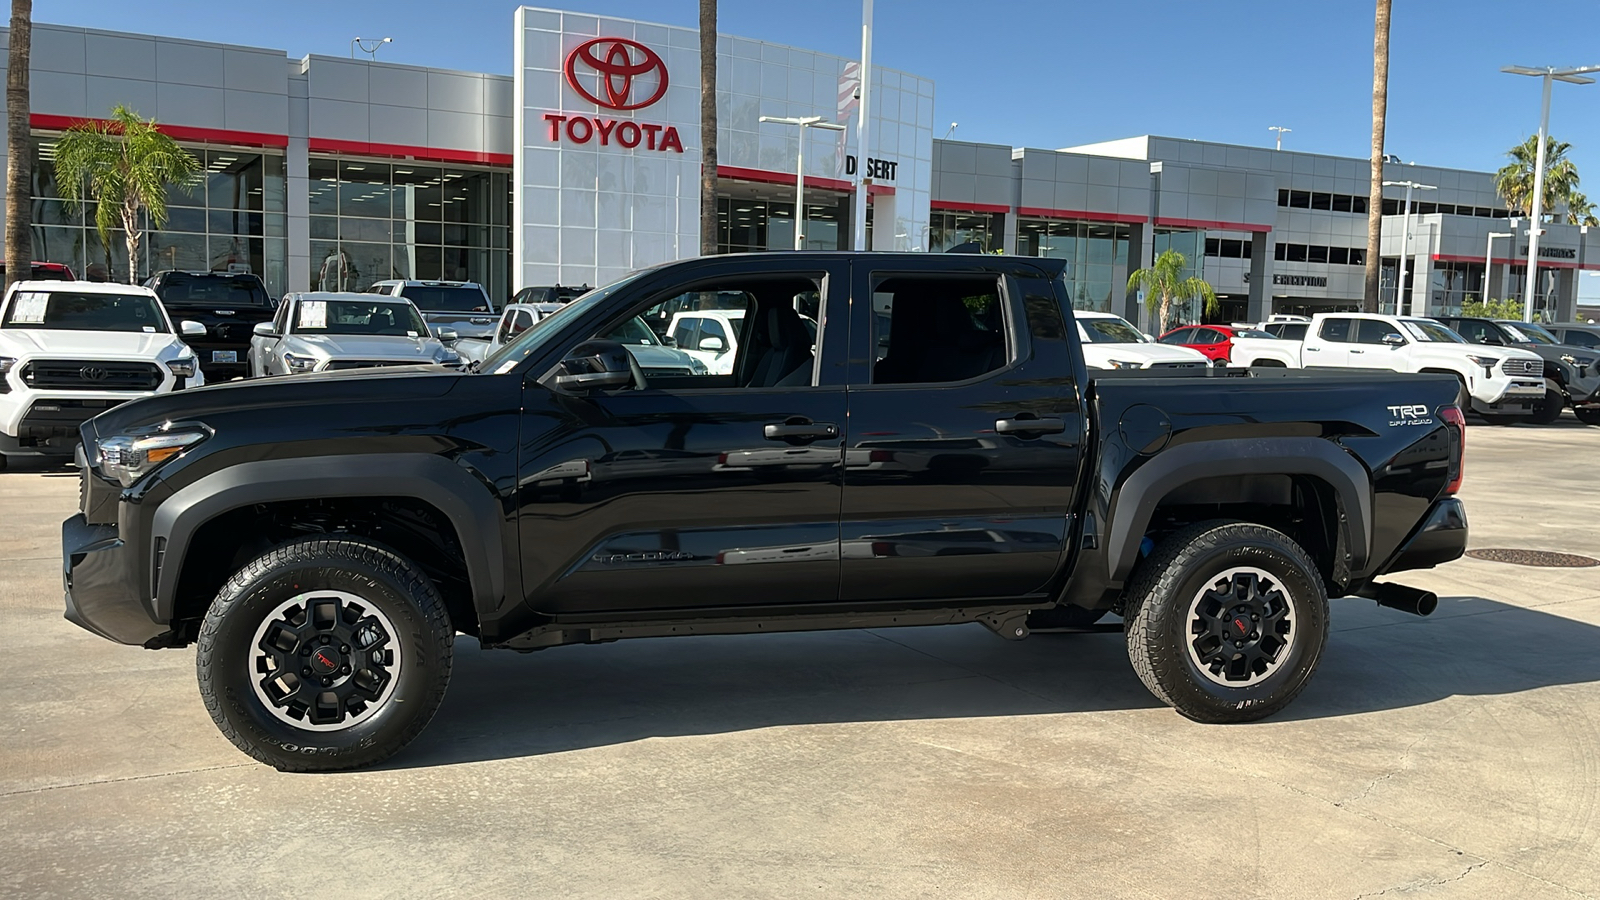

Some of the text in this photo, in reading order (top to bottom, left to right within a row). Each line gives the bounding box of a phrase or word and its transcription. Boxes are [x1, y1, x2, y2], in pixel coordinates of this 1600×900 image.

[543, 114, 684, 153] TOYOTA
[846, 155, 898, 181] DSERT
[1387, 404, 1428, 419] TRD
[592, 551, 695, 563] TACOMA
[317, 652, 335, 669] TRD
